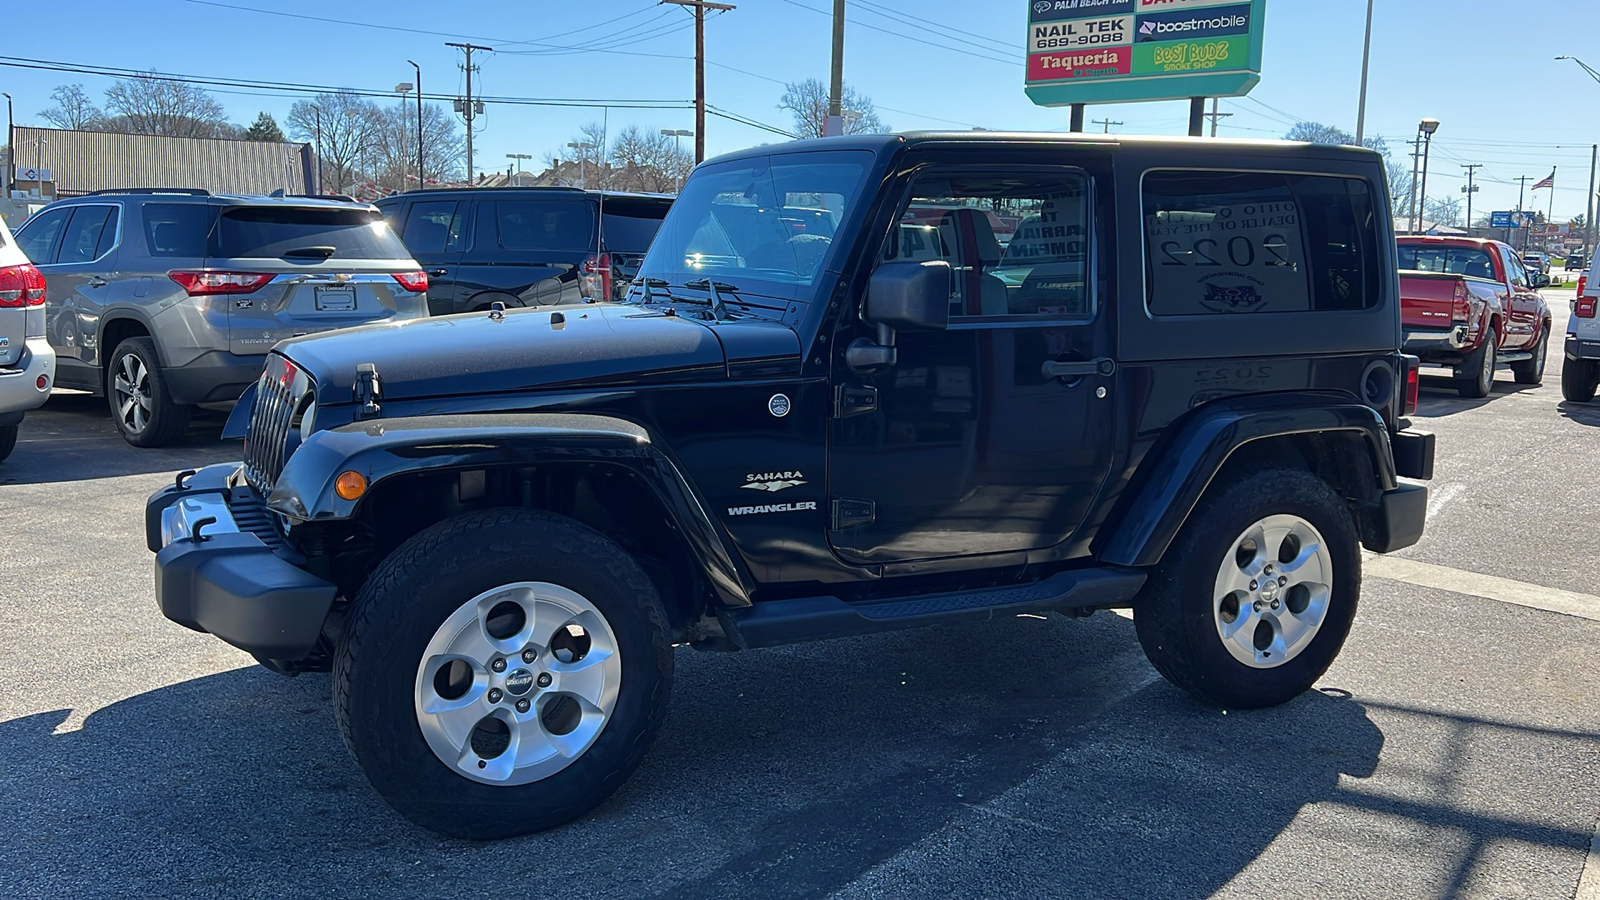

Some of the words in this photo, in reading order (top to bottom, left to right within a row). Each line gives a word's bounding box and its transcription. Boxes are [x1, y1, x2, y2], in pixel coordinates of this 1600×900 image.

[1054, 0, 1078, 10] PALM
[1080, 0, 1109, 8] BEACH
[1035, 24, 1077, 38] NAIL
[1085, 19, 1125, 33] TEK
[1037, 32, 1123, 49] 689-9088
[1189, 41, 1229, 62] BUDZ
[1040, 50, 1118, 71] Taquería
[1163, 62, 1192, 71] SMOKE
[1193, 61, 1217, 69] SHOP
[746, 470, 803, 482] SAHARA
[728, 501, 817, 516] WRANGLER
